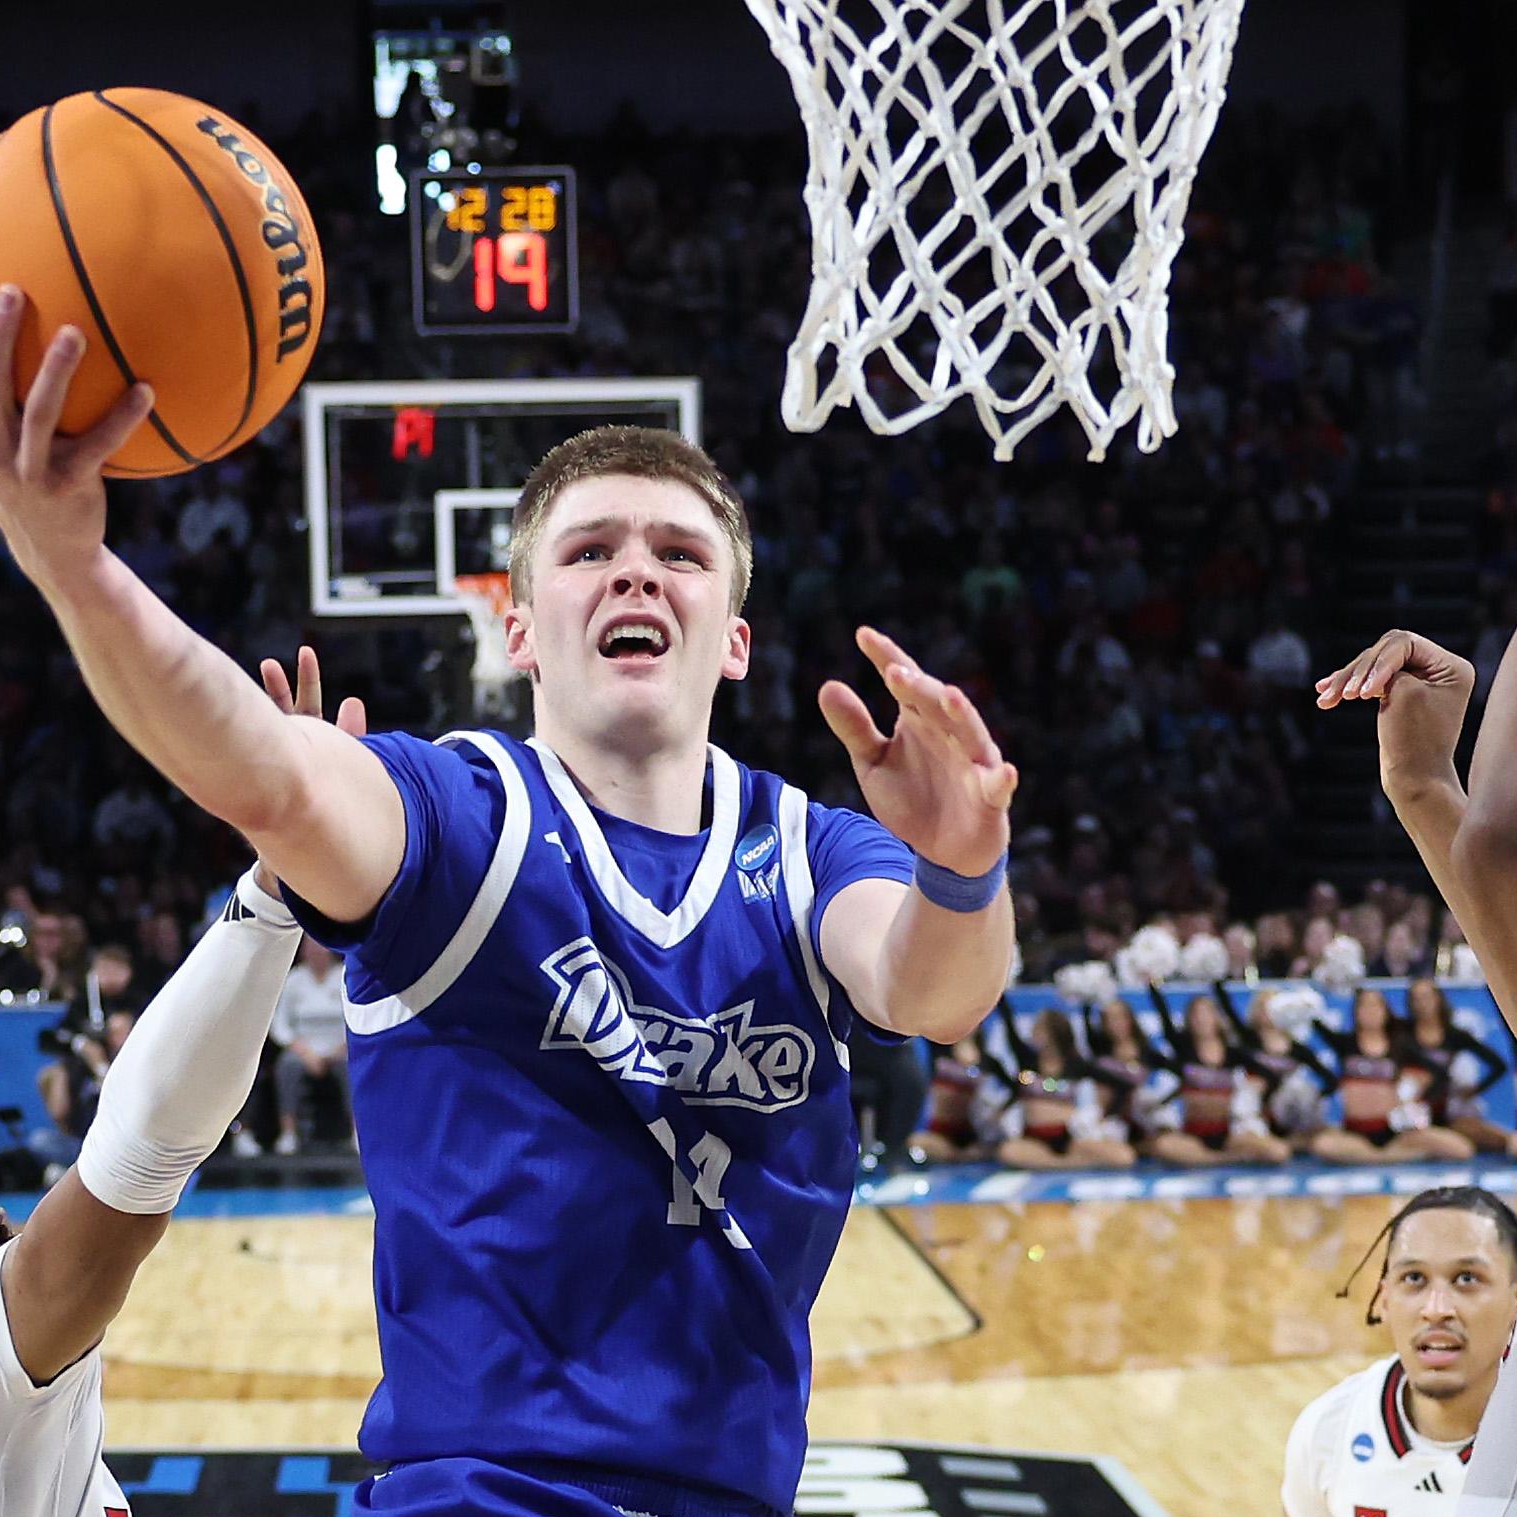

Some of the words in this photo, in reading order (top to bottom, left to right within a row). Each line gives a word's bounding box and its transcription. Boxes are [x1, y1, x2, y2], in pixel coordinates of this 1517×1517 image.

[198, 115, 312, 364] Wilson
[500, 187, 557, 233] 28
[474, 232, 548, 313] 19
[741, 835, 776, 866] NCAA
[540, 936, 816, 1112] Drake
